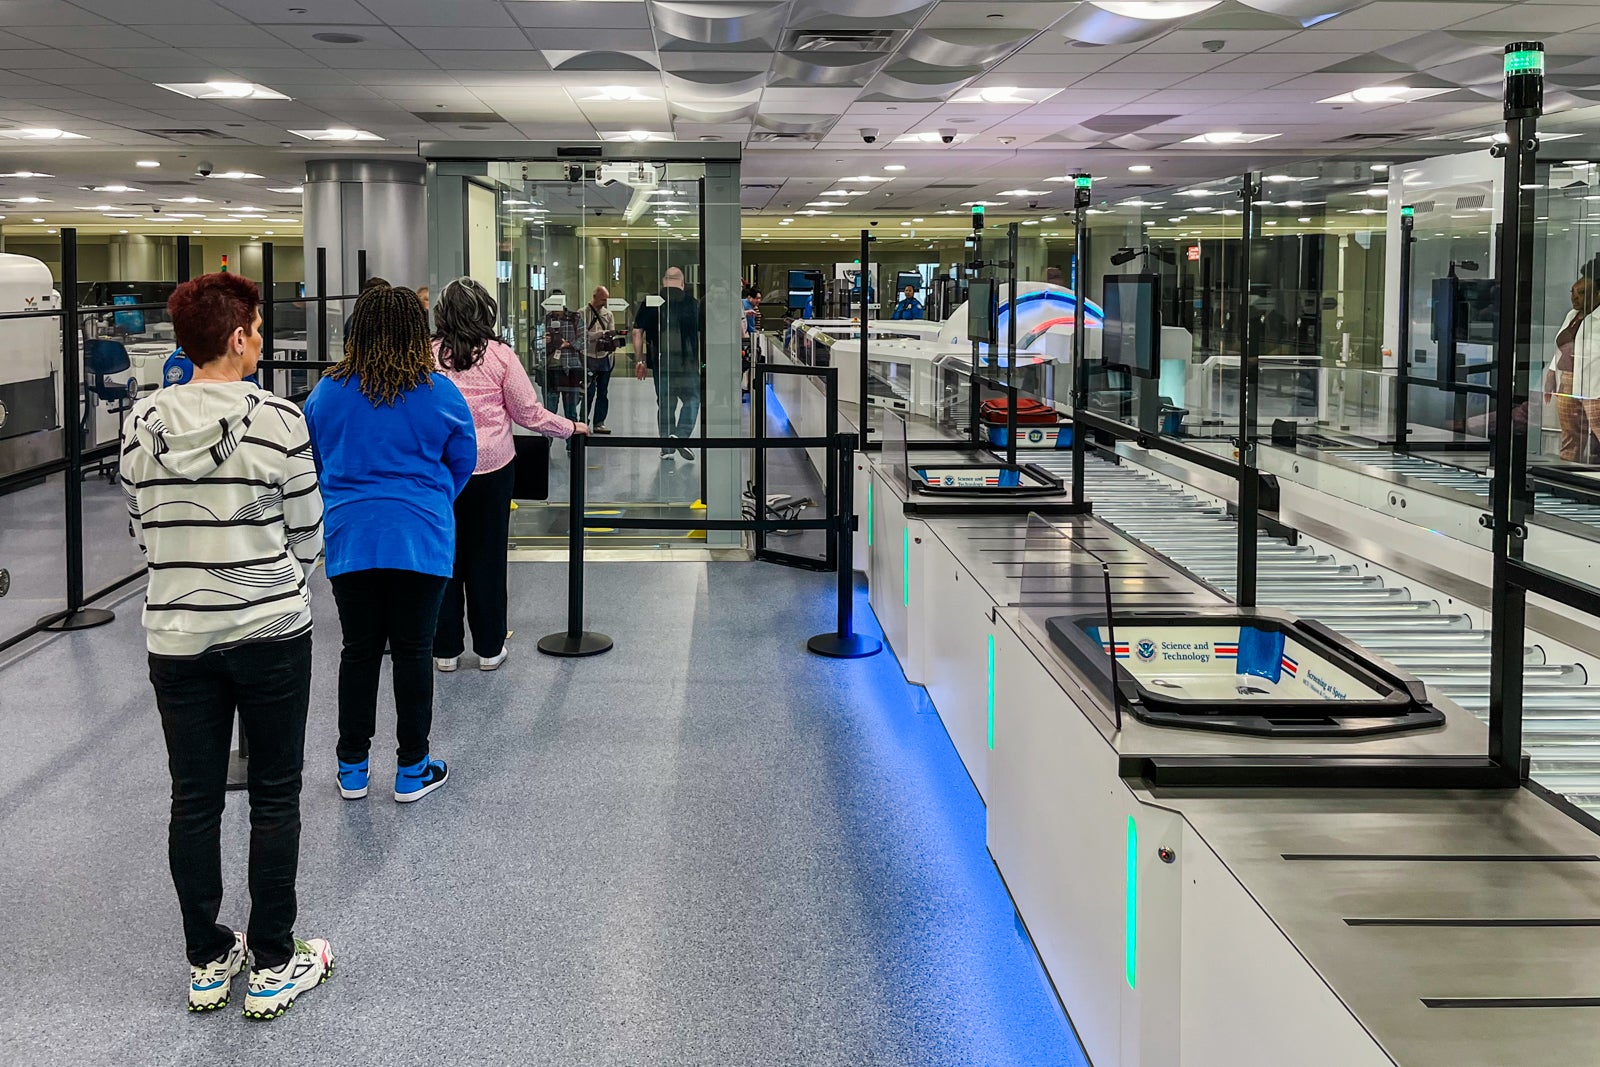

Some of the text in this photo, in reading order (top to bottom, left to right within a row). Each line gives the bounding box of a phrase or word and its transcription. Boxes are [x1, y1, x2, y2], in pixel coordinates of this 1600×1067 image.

[1161, 641, 1209, 650] Science and
[1162, 651, 1210, 663] Technology
[1307, 669, 1327, 691] Screening
[1332, 686, 1347, 700] Speed
